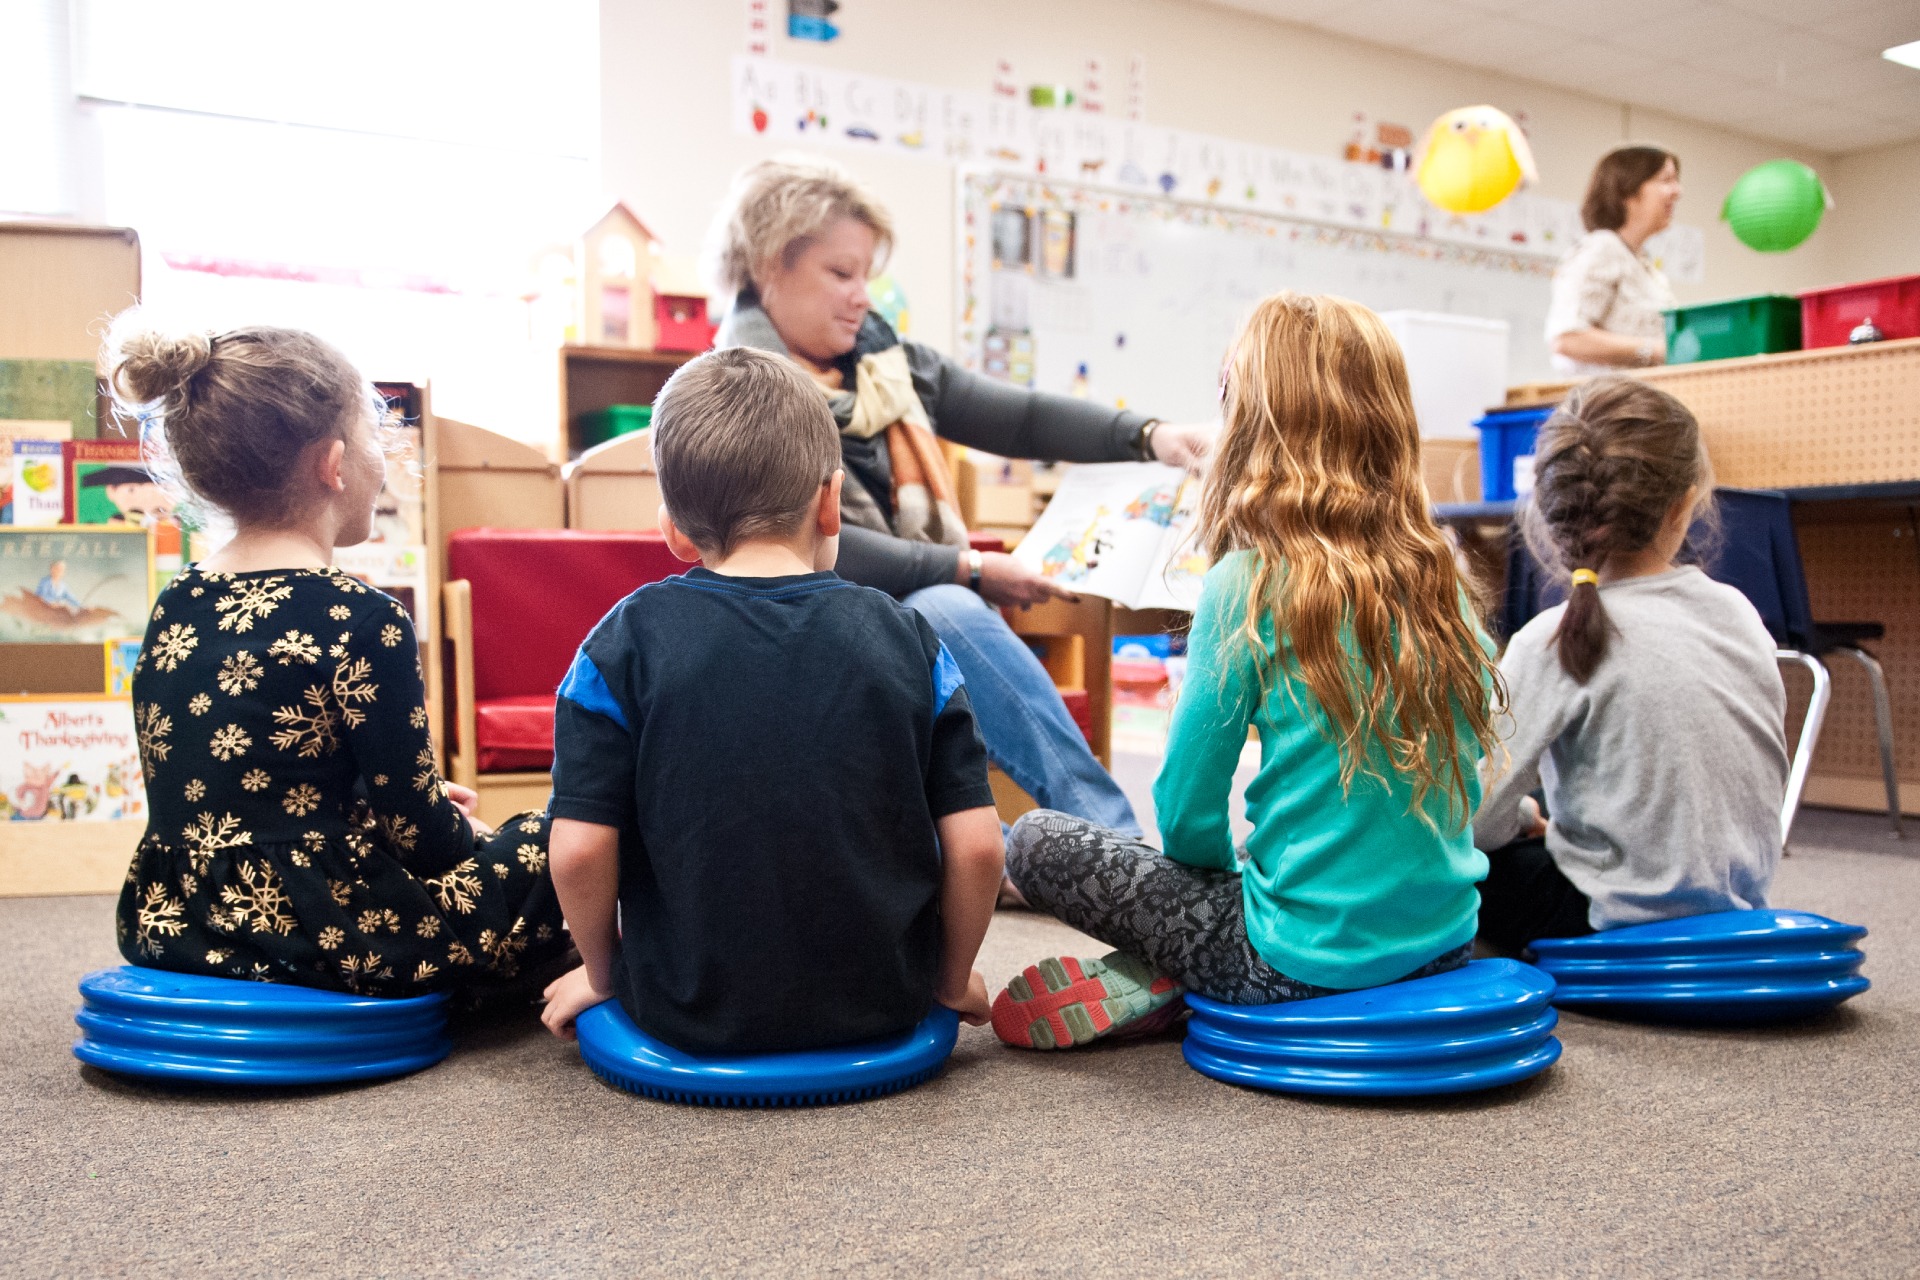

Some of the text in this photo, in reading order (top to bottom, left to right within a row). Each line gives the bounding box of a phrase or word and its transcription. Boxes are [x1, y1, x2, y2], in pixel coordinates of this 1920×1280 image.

[29, 497, 63, 510] Than
[62, 541, 121, 559] FALL
[43, 711, 104, 729] Albert's
[18, 730, 129, 751] Thanksgiving
